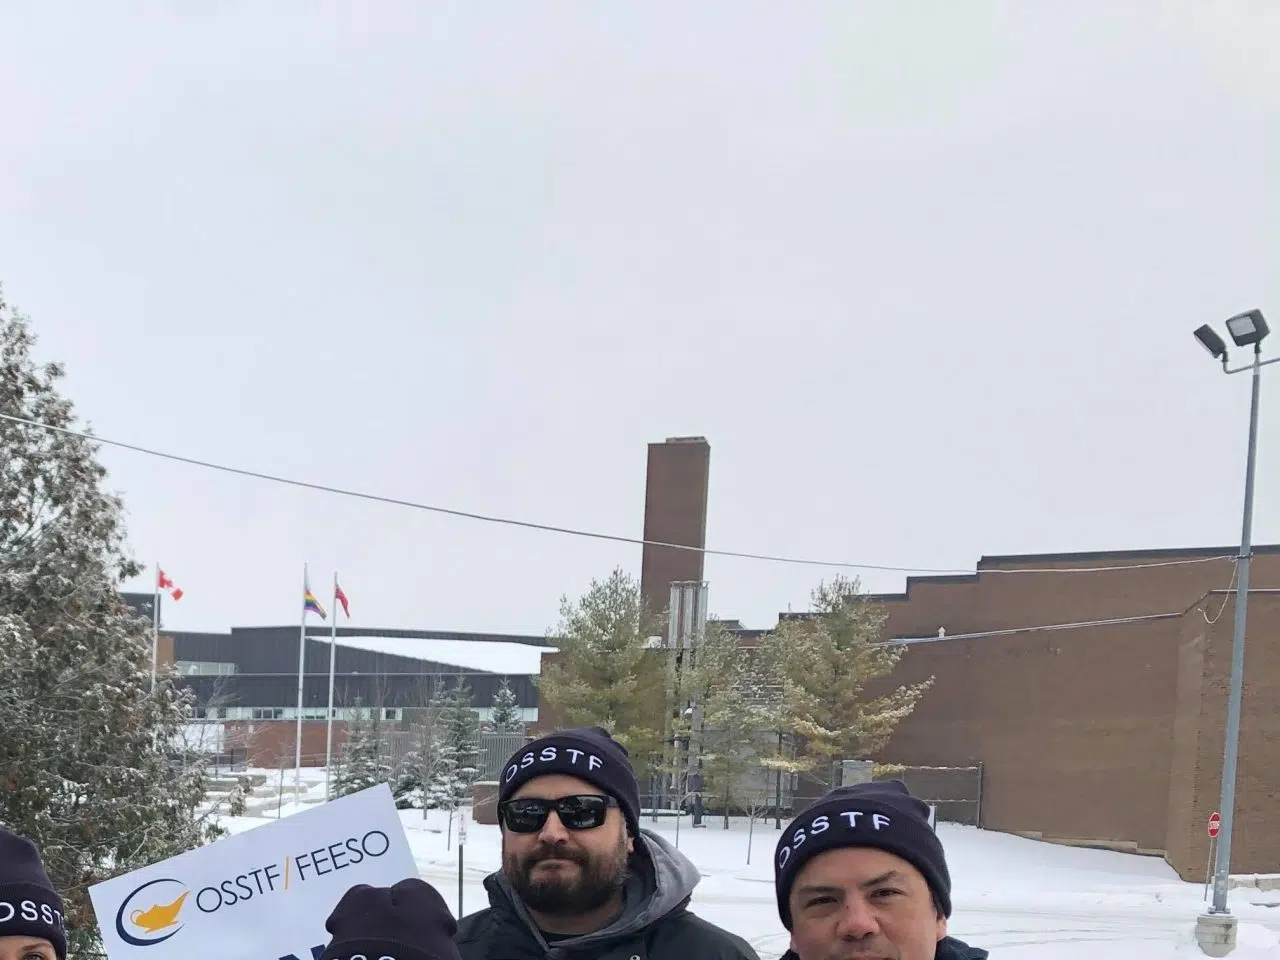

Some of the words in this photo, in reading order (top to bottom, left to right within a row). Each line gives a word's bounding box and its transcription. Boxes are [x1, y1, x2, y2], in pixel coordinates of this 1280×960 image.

[505, 746, 603, 783] OSSTF
[778, 811, 891, 870] OSSTF
[195, 830, 390, 914] OSSTF/FEESO
